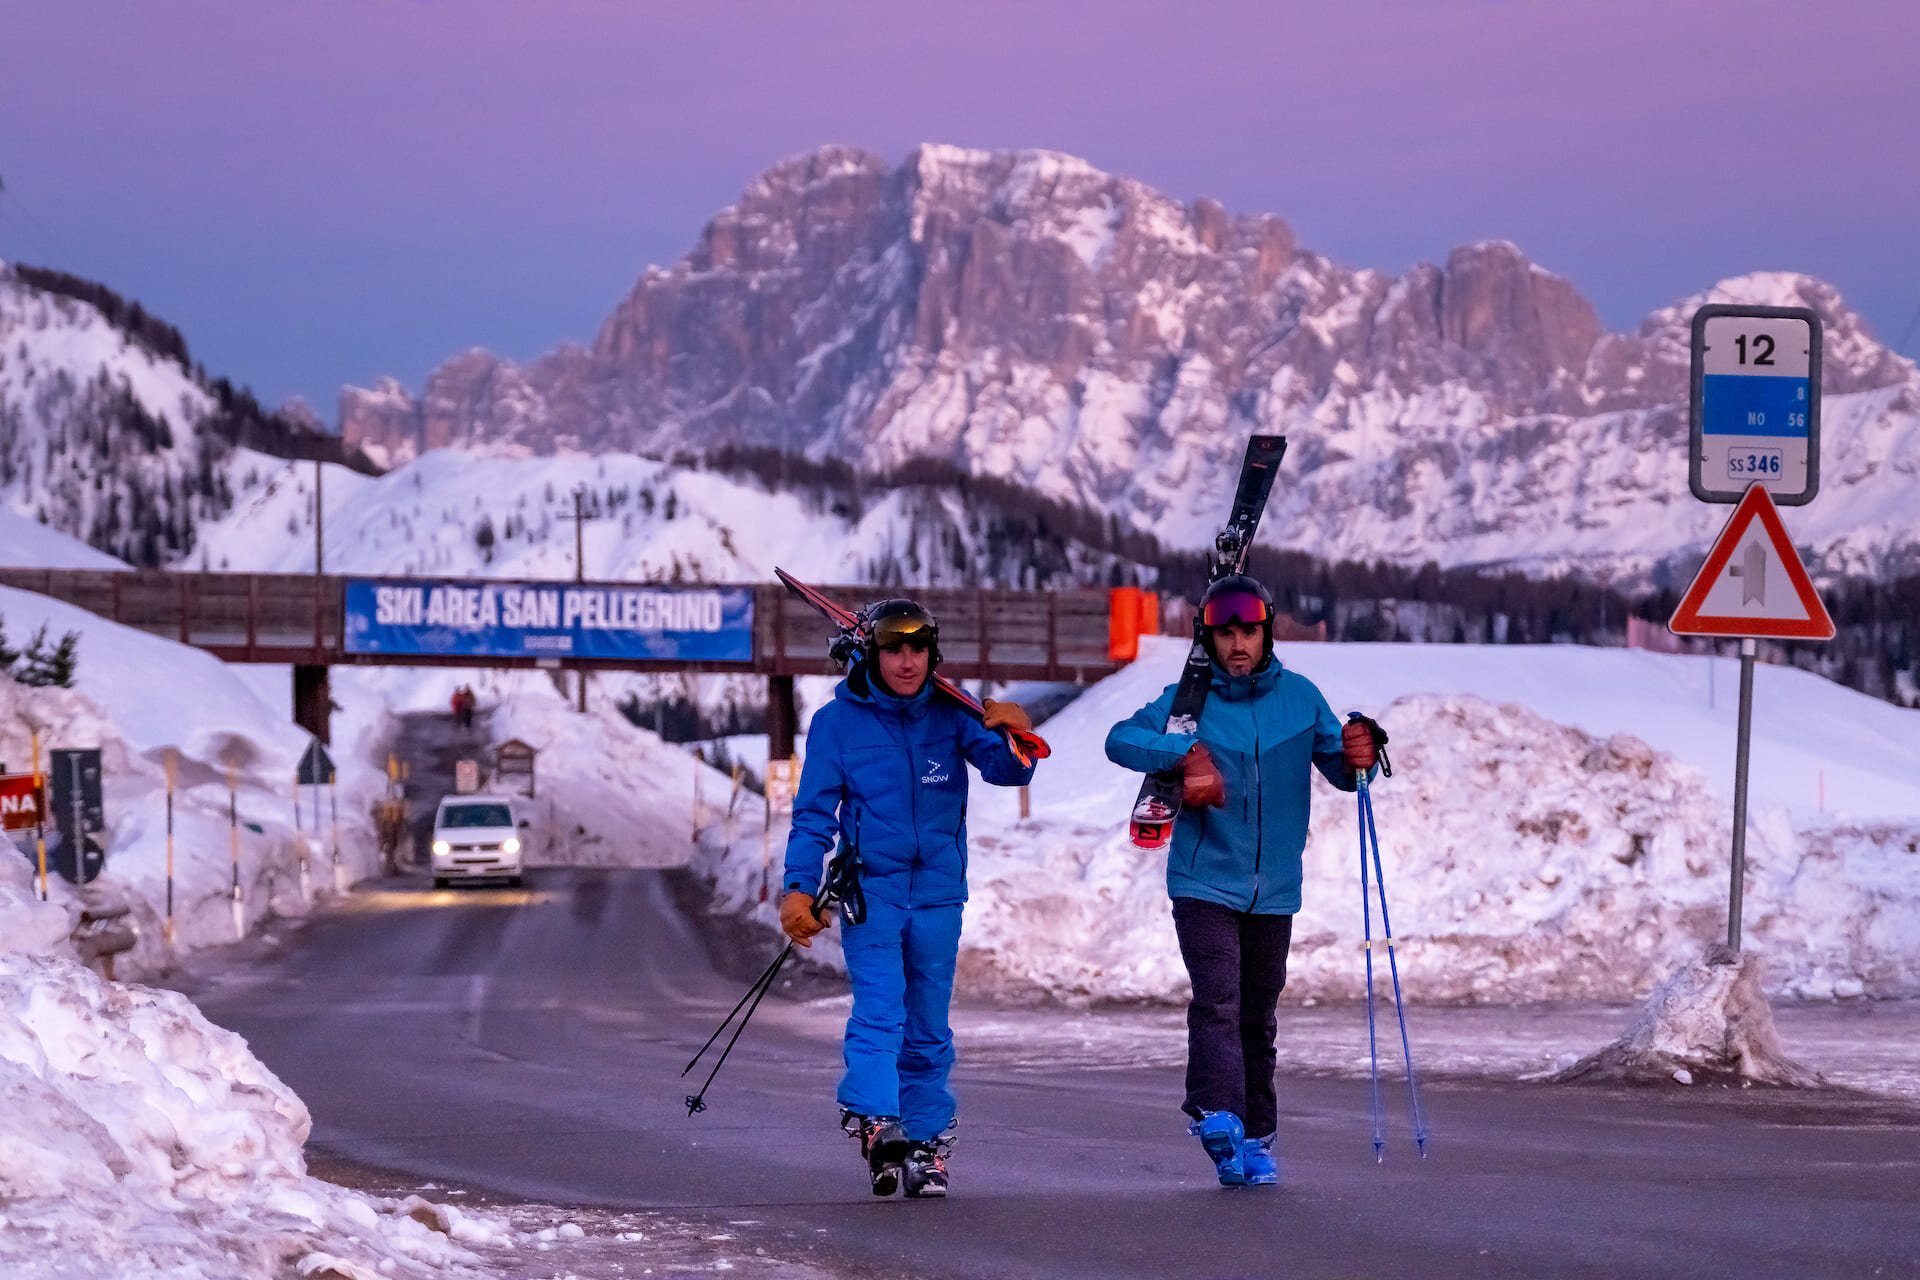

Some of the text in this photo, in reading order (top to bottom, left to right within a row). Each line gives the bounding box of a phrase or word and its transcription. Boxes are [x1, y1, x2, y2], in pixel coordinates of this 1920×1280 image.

[1735, 334, 1775, 366] 12
[1797, 387, 1804, 401] 8
[1748, 412, 1804, 427] NO 56
[1730, 454, 1779, 473] SS 346
[502, 589, 559, 628] SAN
[563, 590, 722, 632] PELLEGRINO
[921, 774, 949, 784] SNOW
